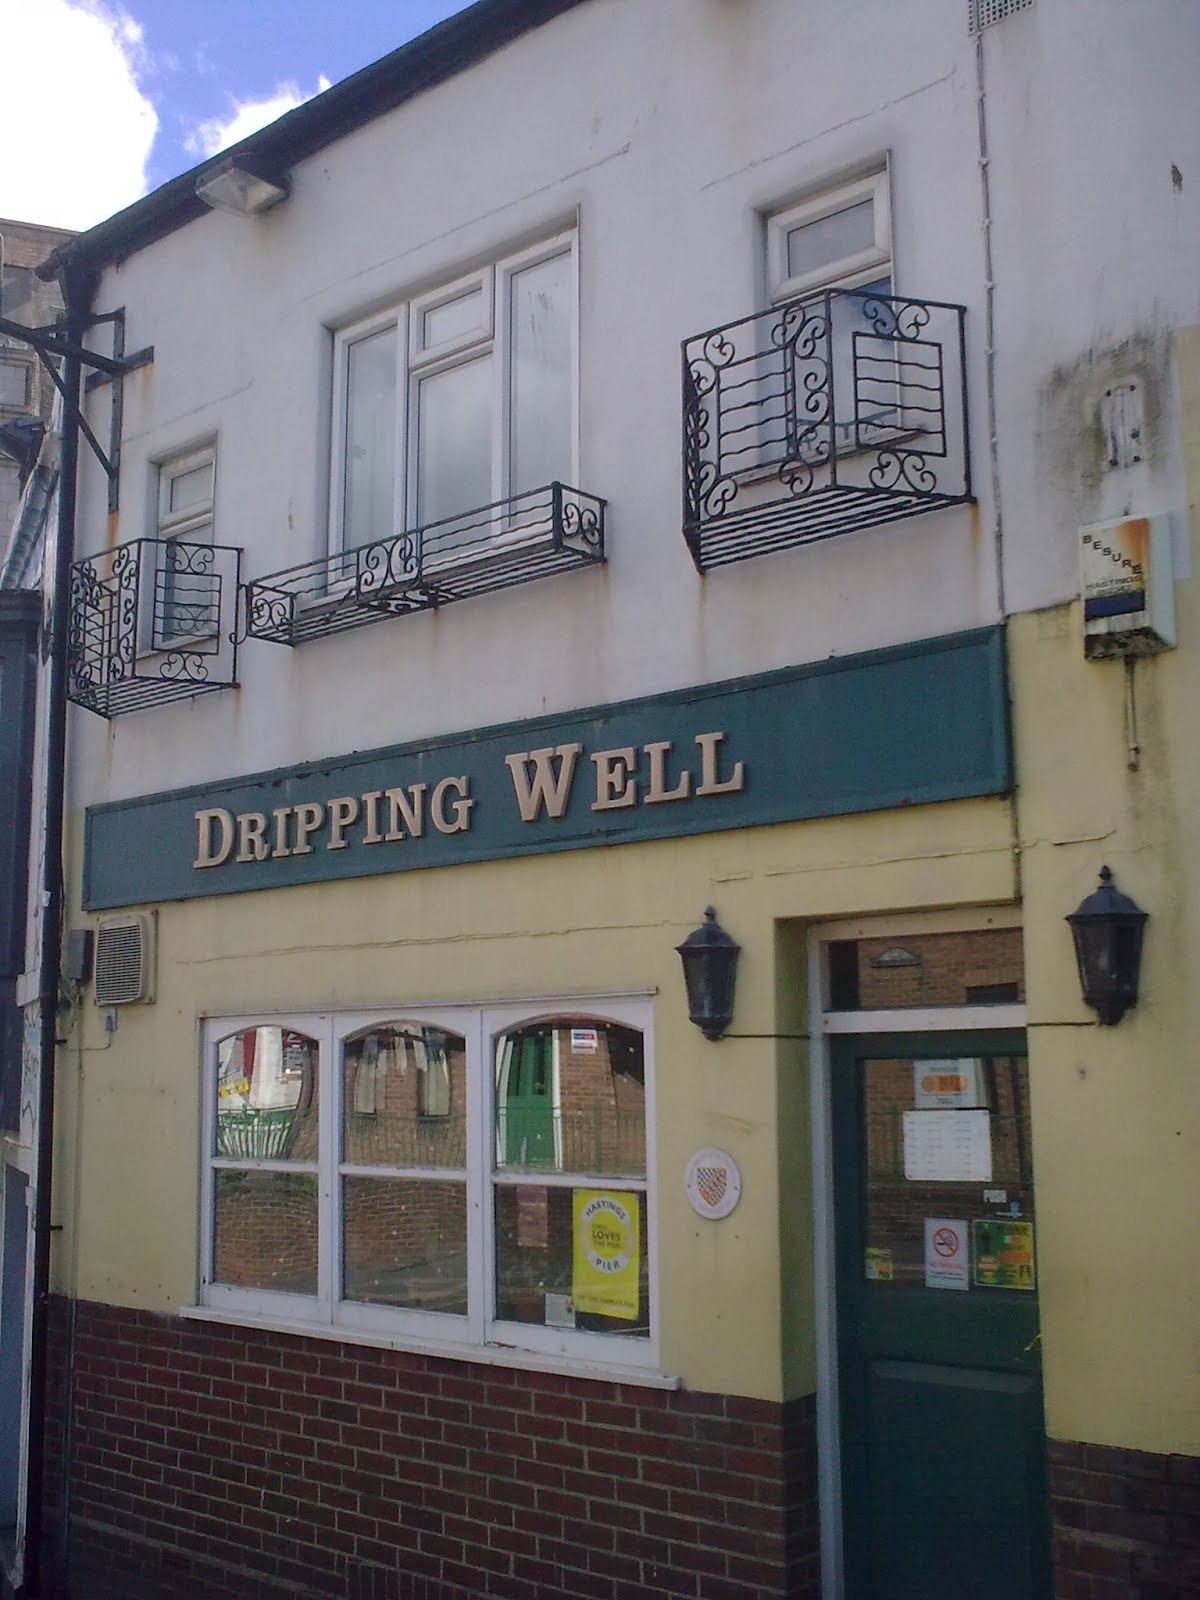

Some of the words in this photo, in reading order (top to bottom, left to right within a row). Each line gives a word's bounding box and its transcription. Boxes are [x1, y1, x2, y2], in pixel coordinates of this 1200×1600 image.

[193, 775, 475, 870] DRIPPING
[504, 731, 745, 822] WELL
[586, 1199, 626, 1220] HASTINGS
[592, 1229, 621, 1241] LOVES
[596, 1257, 621, 1270] PIER
